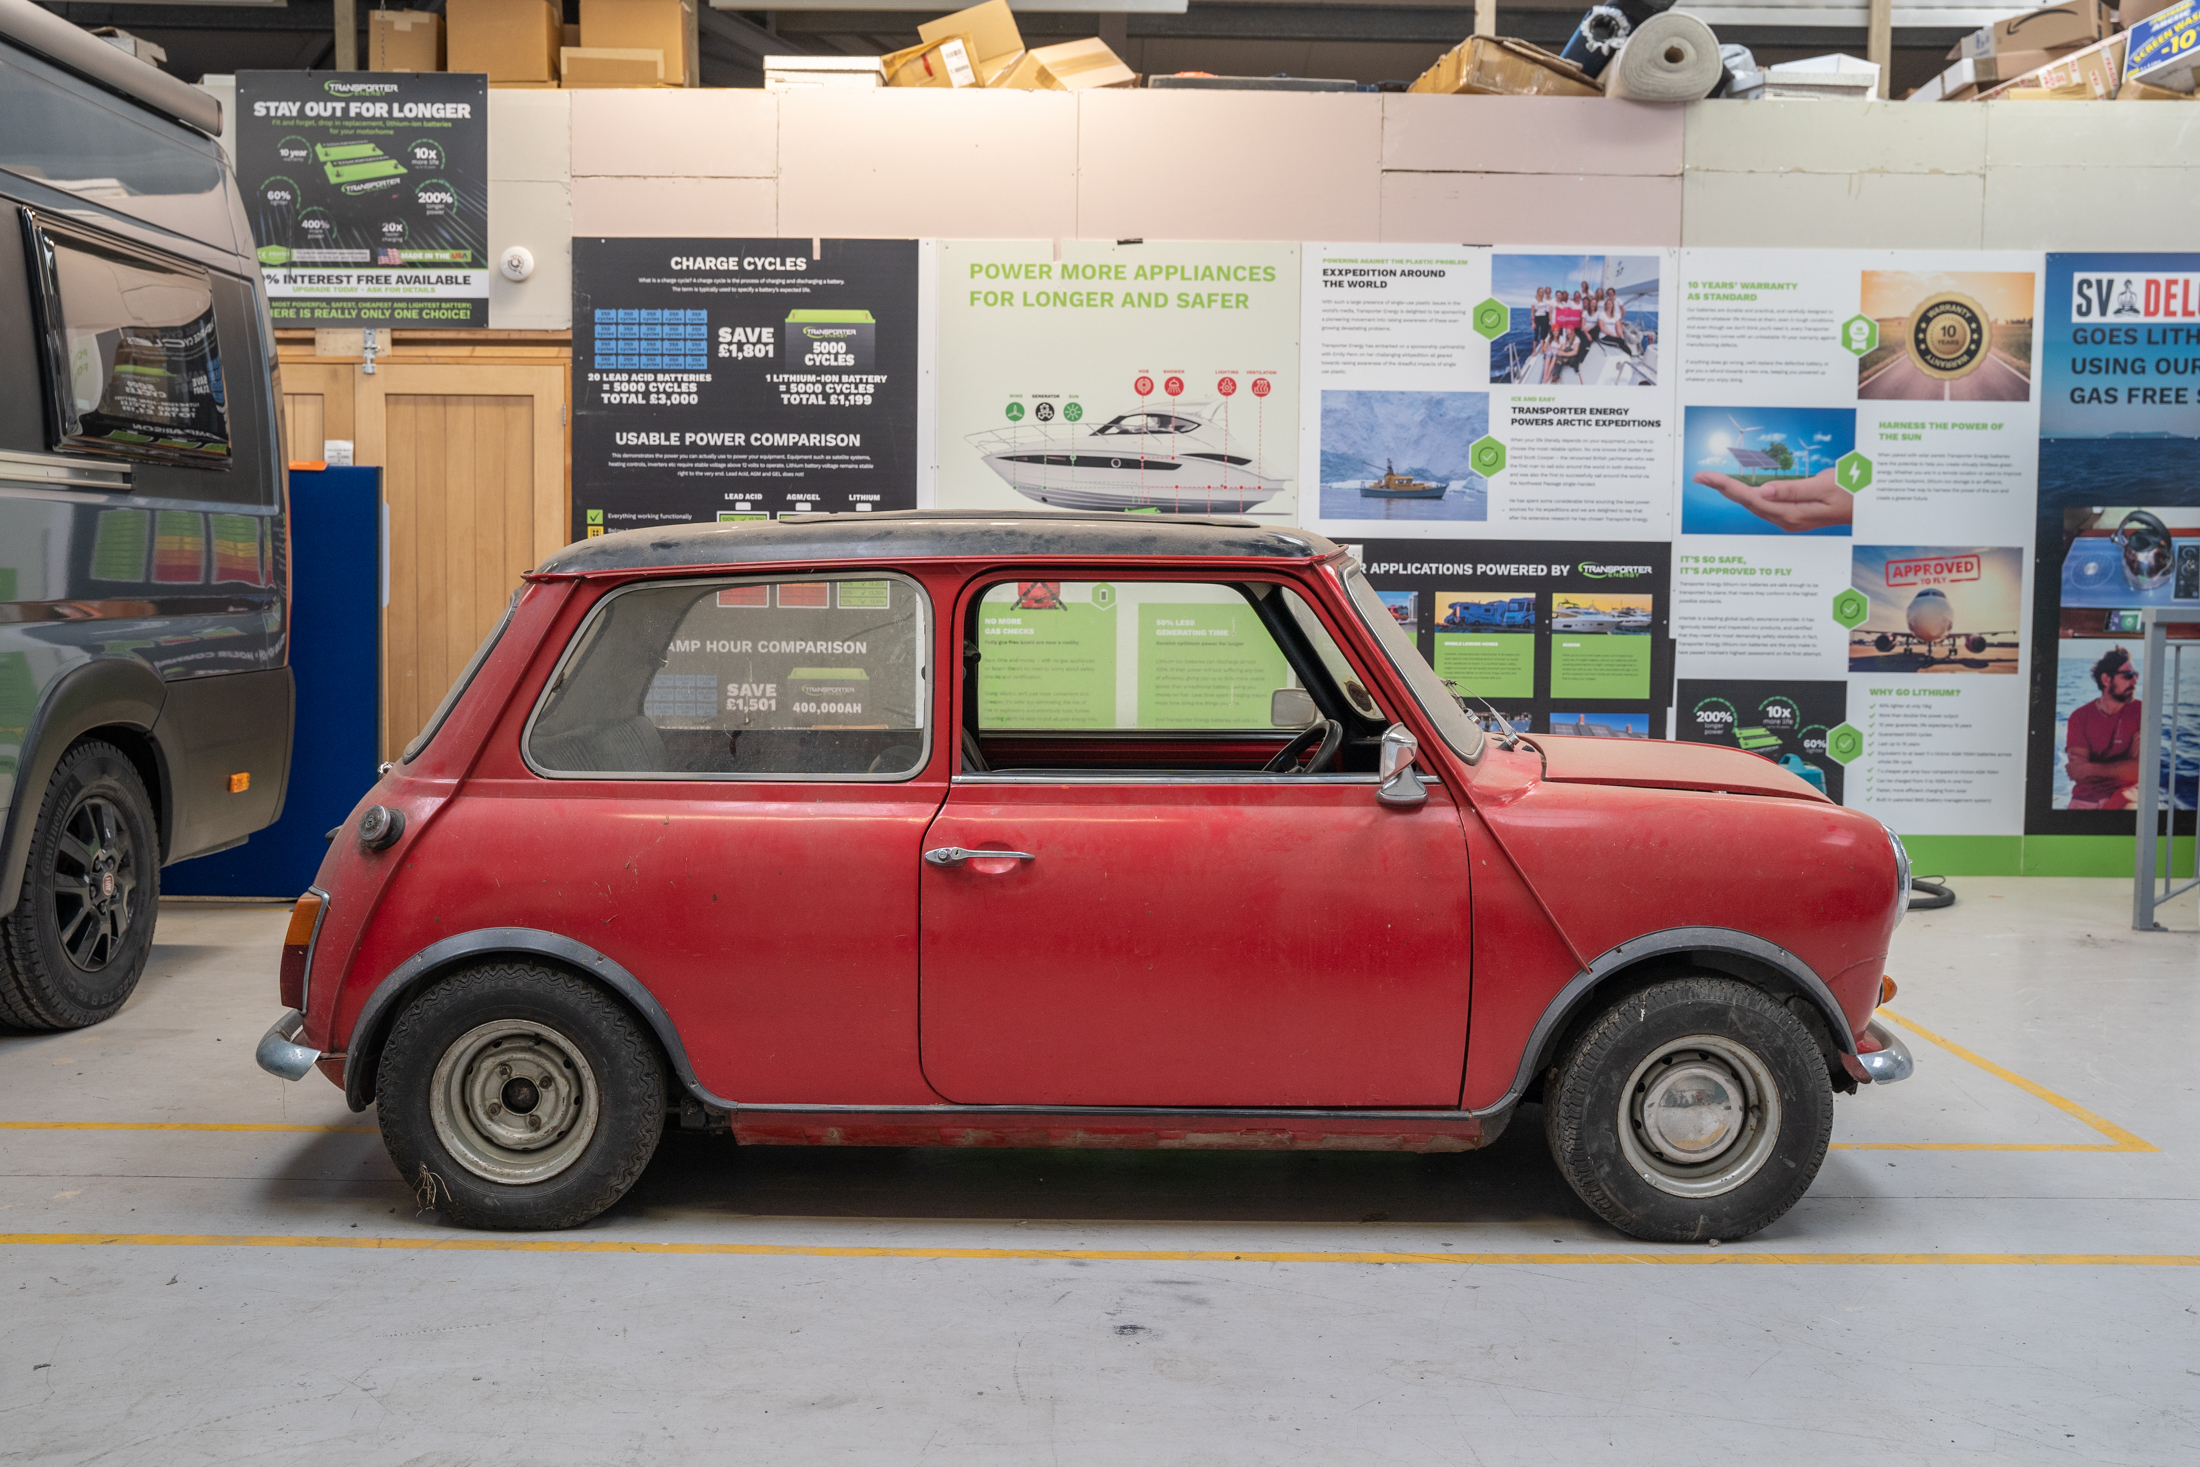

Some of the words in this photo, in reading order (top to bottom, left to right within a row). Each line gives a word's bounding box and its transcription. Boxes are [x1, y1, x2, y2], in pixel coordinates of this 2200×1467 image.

[2133, 28, 2173, 63] SCREEN
[329, 83, 398, 92] TRANSPORTER
[253, 101, 301, 117] STAY
[304, 101, 345, 117] OUT
[349, 102, 389, 117] FOR
[392, 102, 471, 118] LONGER
[279, 148, 289, 156] 10
[289, 149, 307, 159] year
[413, 147, 436, 159] 10x
[267, 190, 291, 200] 60%
[417, 191, 453, 203] 200%
[301, 219, 329, 229] 400%
[382, 222, 403, 232] 20x
[400, 252, 422, 260] MADE
[670, 256, 739, 270] CHARGE
[742, 256, 806, 271] CYCLES
[970, 263, 1052, 280] POWER
[1060, 263, 1126, 280] MORE
[1133, 264, 1276, 282] APPLIANCES
[1322, 268, 1396, 277] EXXPEDITION
[1399, 269, 1445, 277] AROUND
[283, 273, 352, 284] INTEREST
[356, 274, 392, 284] FREE
[395, 275, 471, 285] AVAILABLE
[1322, 279, 1344, 288] THE
[1347, 280, 1387, 288] WORLD
[1739, 281, 1798, 290] WARRANTY
[969, 290, 1014, 307] FOR
[1022, 290, 1114, 308] LONGER
[1120, 292, 1168, 308] AND
[1176, 292, 1249, 309] SAFER
[1687, 292, 1700, 300] AS
[1703, 292, 1757, 301] STANDARD
[2076, 278, 2115, 317] SV
[2143, 278, 2200, 318] DEL
[299, 308, 311, 318] IS
[314, 308, 357, 318] REALLY
[360, 308, 391, 318] ONLY
[394, 308, 419, 319] ONE
[422, 309, 470, 319] CHOICE!
[1926, 303, 1973, 319] WARRANTY
[718, 326, 774, 343] SAVE
[1941, 324, 1956, 338] 10
[2072, 327, 2138, 345] GOES
[813, 341, 846, 353] 5000
[1937, 339, 1960, 347] YEARS
[718, 343, 774, 360] £1,801
[804, 353, 854, 366] CYCLES
[1924, 353, 1971, 369] WARRANTY
[2071, 357, 2146, 375] USING
[587, 372, 600, 381] 20
[602, 373, 628, 382] LEAD
[630, 373, 654, 382] ACID
[656, 373, 712, 382] BATTERIES
[765, 374, 770, 382] 1
[773, 374, 840, 383] LITHIUM-ION
[839, 374, 887, 383] BATTERY
[613, 382, 645, 392] 5000
[648, 382, 697, 392] CYCLES
[789, 383, 822, 393] 5000
[825, 383, 874, 393] CYCLES
[600, 393, 646, 404] TOTAL
[649, 393, 698, 406] £3,000
[780, 394, 826, 405] TOTAL
[829, 394, 872, 407] £1,199
[2069, 387, 2118, 404] GAS
[2127, 387, 2188, 404] FREE
[1511, 406, 1587, 415] TRANSPORTER
[1589, 407, 1629, 415] ENERGY
[1510, 418, 1554, 426] POWERS
[1555, 418, 1592, 426] ARCTIC
[1594, 418, 1661, 427] EXPEDITIONS
[1878, 421, 1926, 429] HARNESS
[1929, 422, 1948, 430] THE
[1951, 422, 1988, 430] POWER
[1990, 422, 2004, 431] OF
[615, 431, 680, 445] USABLE
[685, 432, 745, 446] POWER
[749, 432, 860, 446] COMPARISON
[1878, 432, 1898, 441] THE
[1901, 433, 1921, 441] SUN
[724, 492, 744, 500] LEAD
[786, 493, 820, 501] AGM/GEL
[848, 493, 880, 501] LITHIUM
[607, 512, 636, 520] Everything
[659, 512, 692, 520] functionally
[1702, 555, 1716, 563] SO
[1369, 562, 1473, 575] APPLICATIONS
[1476, 563, 1547, 576] POWERED
[1551, 564, 1570, 576] BY
[1582, 565, 1653, 574] TRANSPORTER
[1701, 567, 1756, 575] APPROVED
[1758, 567, 1772, 575] TO
[1774, 567, 1792, 576] FLY
[1892, 560, 1975, 579] APPROVED
[1920, 577, 1931, 585] TO
[1932, 576, 1946, 584] FLY
[1002, 627, 1034, 635] CHECKS
[1155, 628, 1206, 636] GENERATING
[706, 640, 752, 652] HOUR
[757, 639, 866, 654] COMPARISON
[726, 683, 777, 698] SAVE
[1869, 688, 1893, 696] WHY
[1895, 688, 1910, 696] GO
[1912, 688, 1961, 697] LITHIUM?
[726, 697, 776, 712] £1,501
[792, 702, 861, 714] 400,000AH
[1695, 710, 1734, 724] 200%
[1766, 705, 1791, 718] 10x
[1803, 738, 1828, 750] 60%
